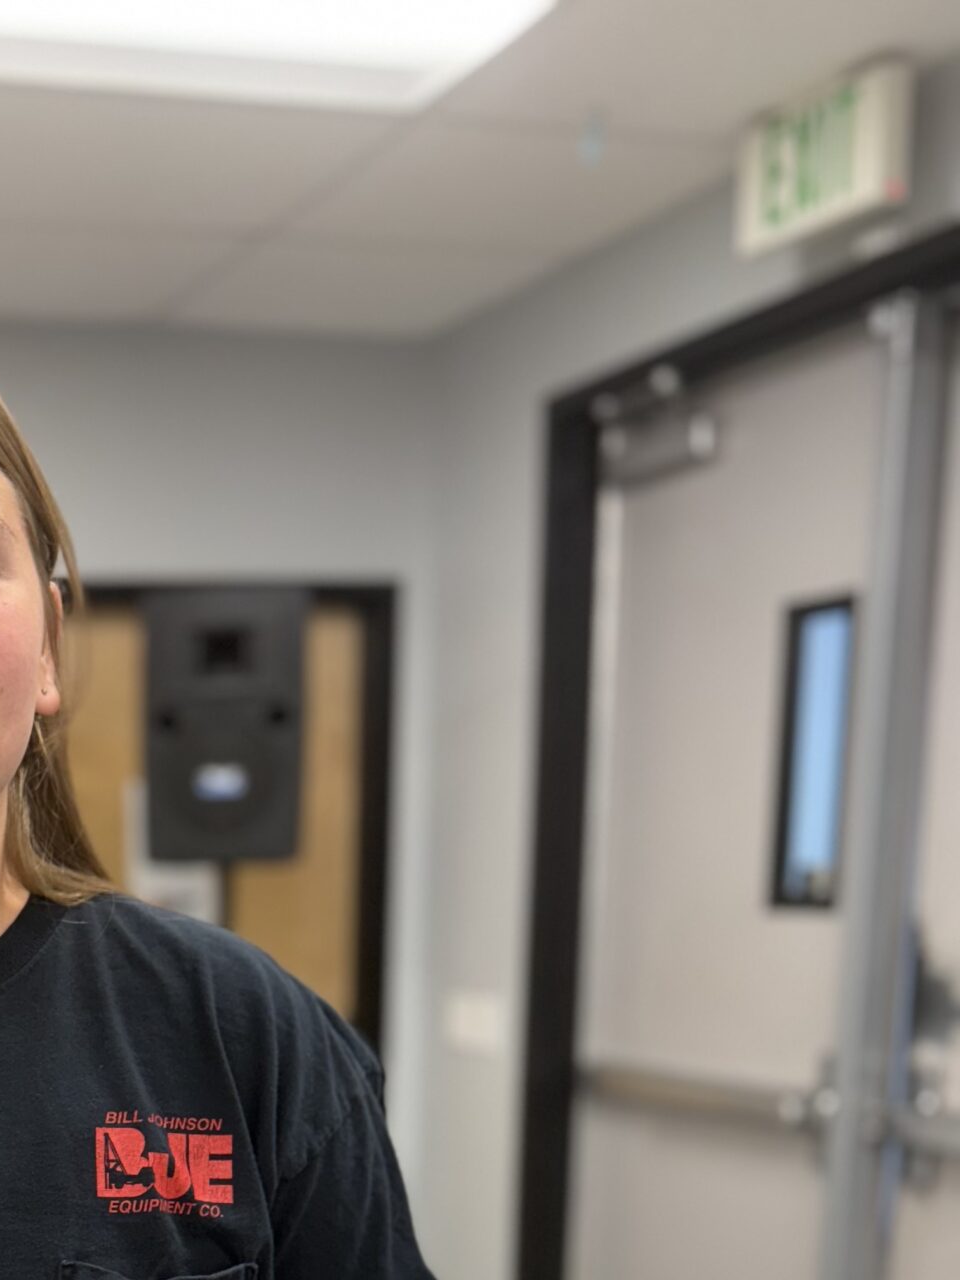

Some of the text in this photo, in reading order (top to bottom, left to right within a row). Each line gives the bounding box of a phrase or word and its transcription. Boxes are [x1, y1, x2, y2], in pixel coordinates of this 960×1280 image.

[105, 1110, 222, 1131] BILL JOHNSON
[109, 1199, 223, 1217] EQUIPMENT CO.
